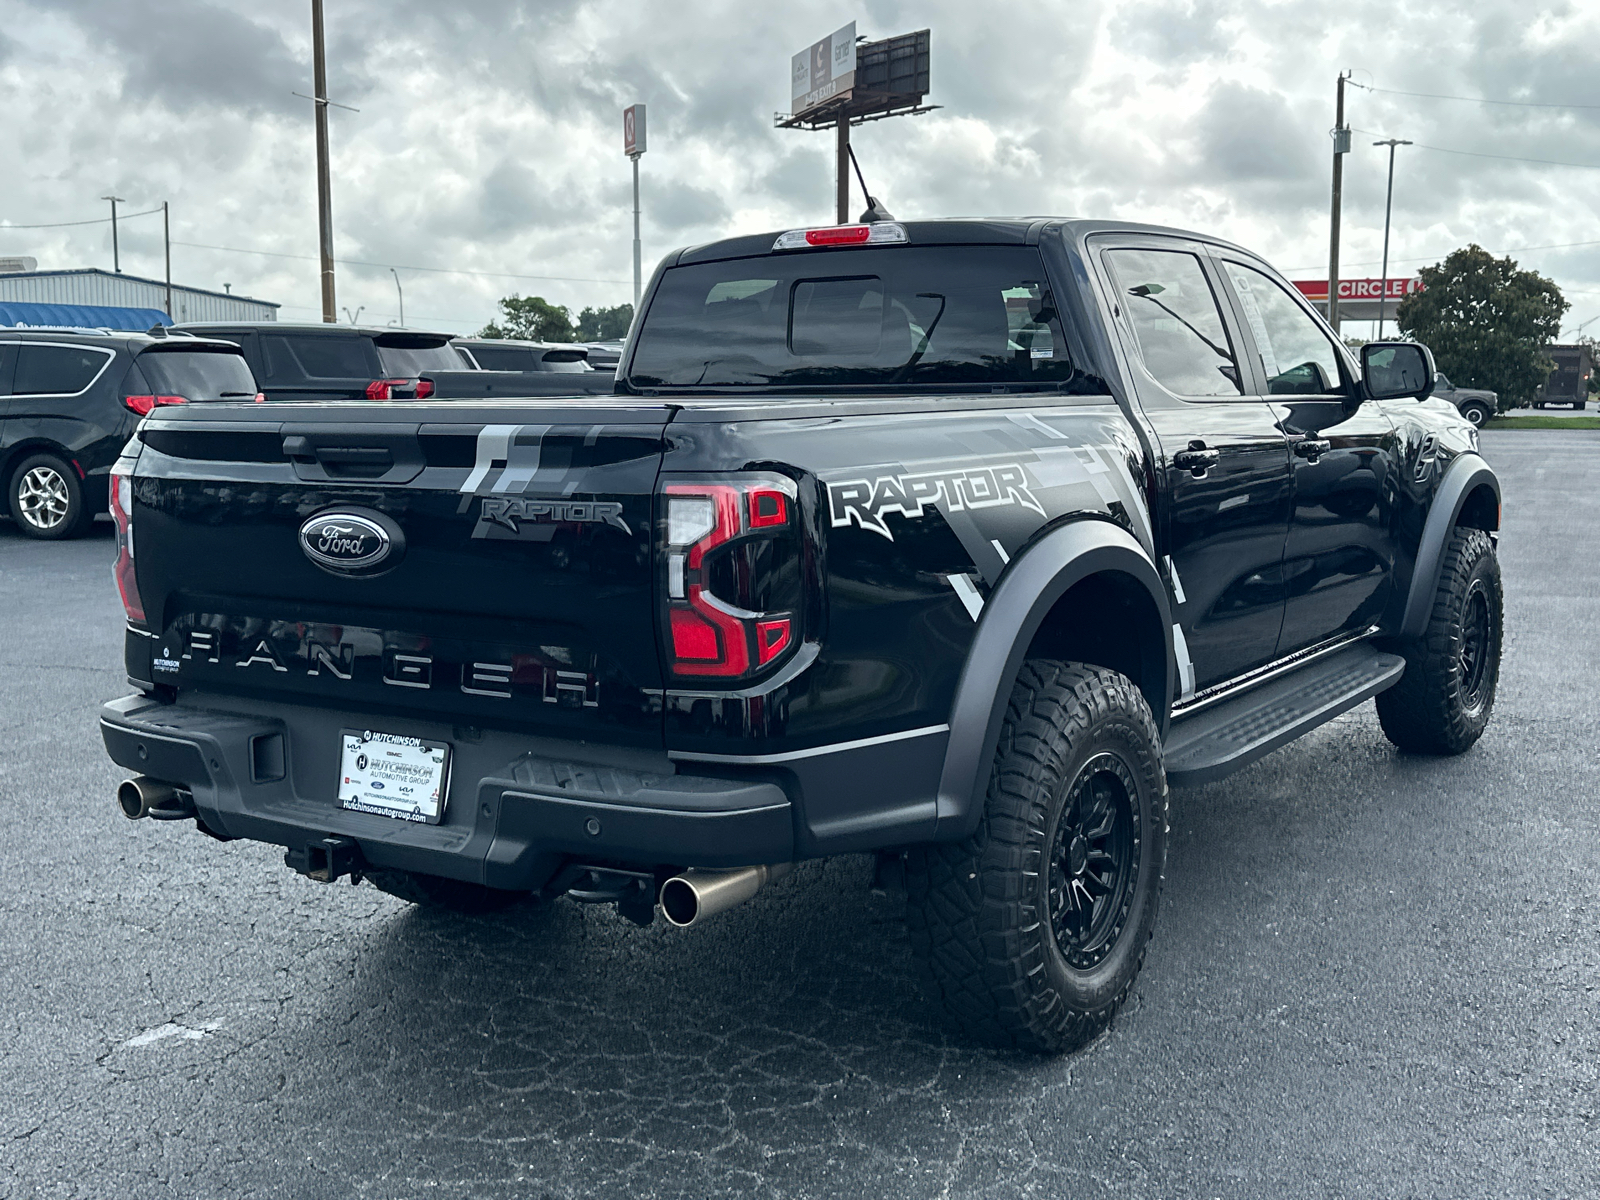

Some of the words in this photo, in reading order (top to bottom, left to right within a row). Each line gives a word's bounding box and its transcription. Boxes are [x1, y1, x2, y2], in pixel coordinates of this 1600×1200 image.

[819, 82, 832, 99] EXIT
[1338, 280, 1403, 296] CIRCLE
[825, 462, 1048, 542] RAPTOR
[481, 498, 633, 536] RAPTOR
[318, 525, 365, 555] Ford
[180, 629, 600, 708] RANGER
[372, 732, 421, 747] HUTCHINSON
[370, 758, 434, 779] HUTCHINSON
[370, 771, 408, 783] AUTOMOTIVE
[409, 776, 430, 785] GROUP
[343, 800, 427, 823] Hutchinsonautogroup.com
